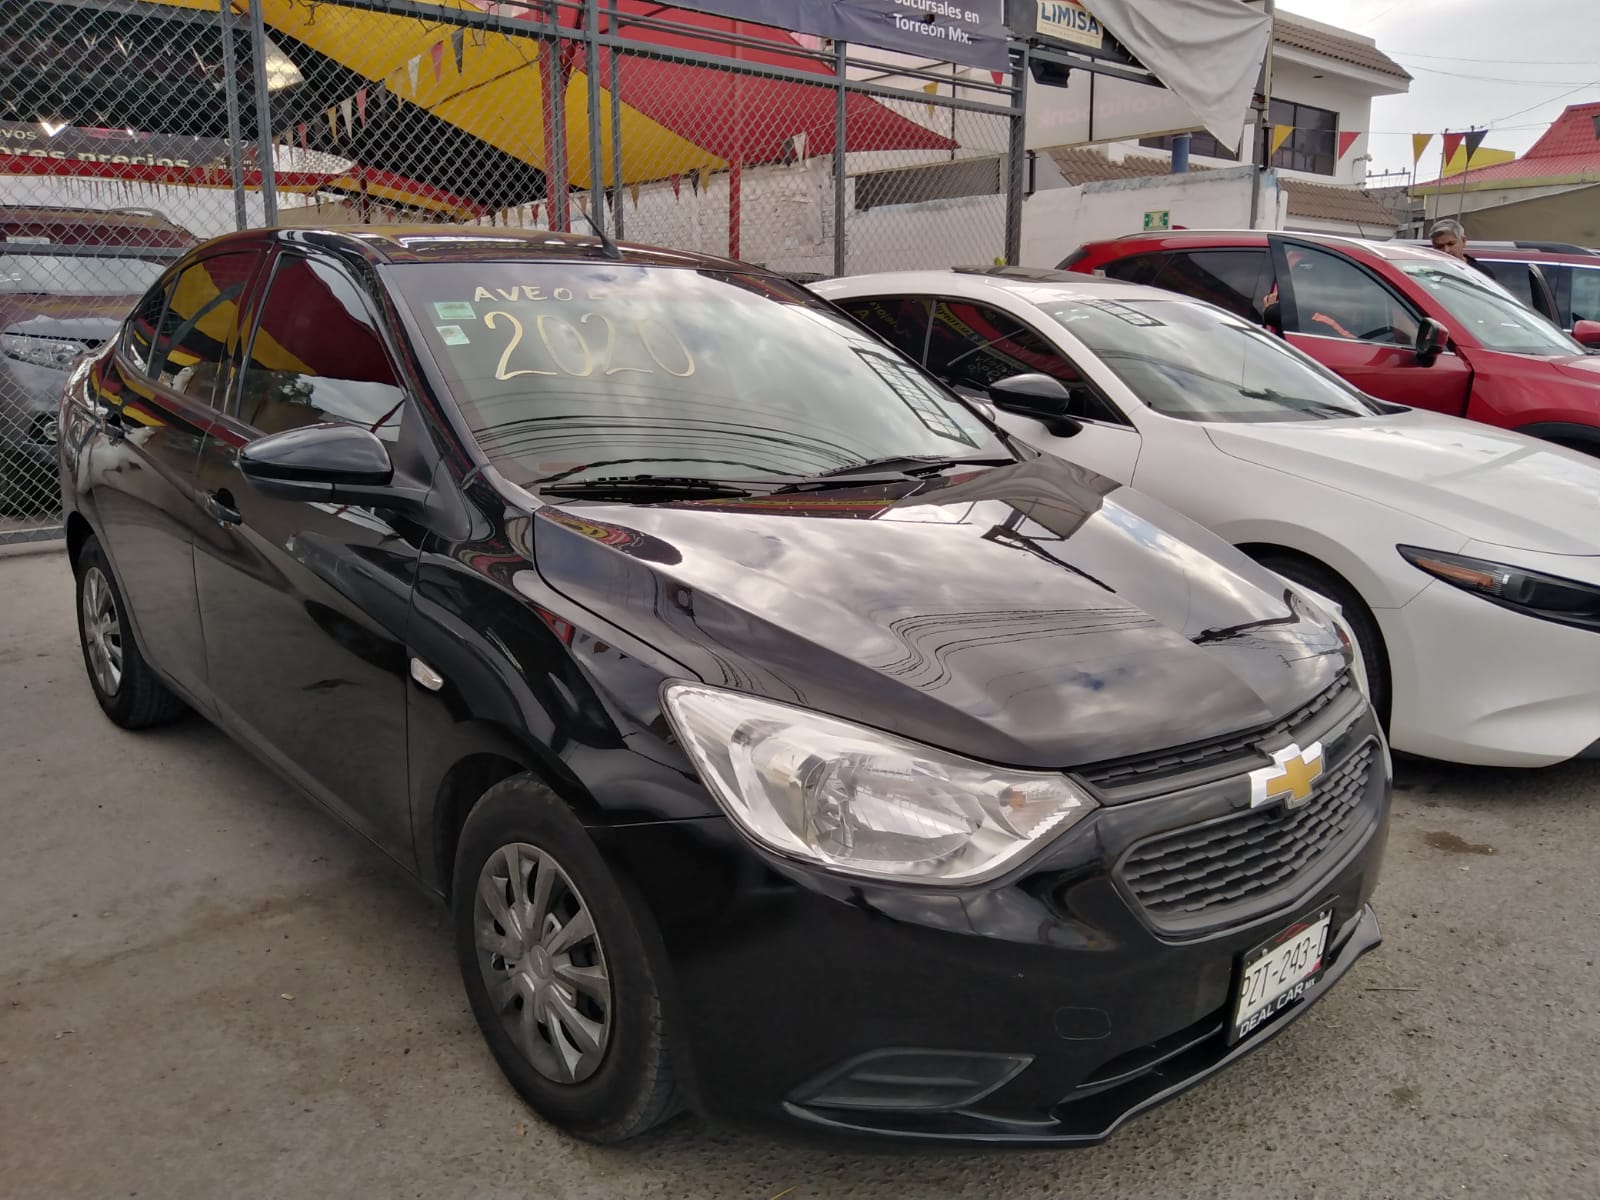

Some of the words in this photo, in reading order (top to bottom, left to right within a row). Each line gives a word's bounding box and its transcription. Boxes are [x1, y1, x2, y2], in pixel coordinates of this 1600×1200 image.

[894, 0, 961, 19] ucursales
[964, 10, 980, 24] en
[1041, 3, 1099, 35] LIMISA
[893, 13, 945, 39] Torreón
[948, 26, 972, 45] Mx.
[0, 128, 37, 140] vos
[474, 286, 573, 302] AVEO
[484, 311, 696, 380] 2020
[1238, 1003, 1274, 1038] DEAL
[1276, 981, 1304, 1009] CAR
